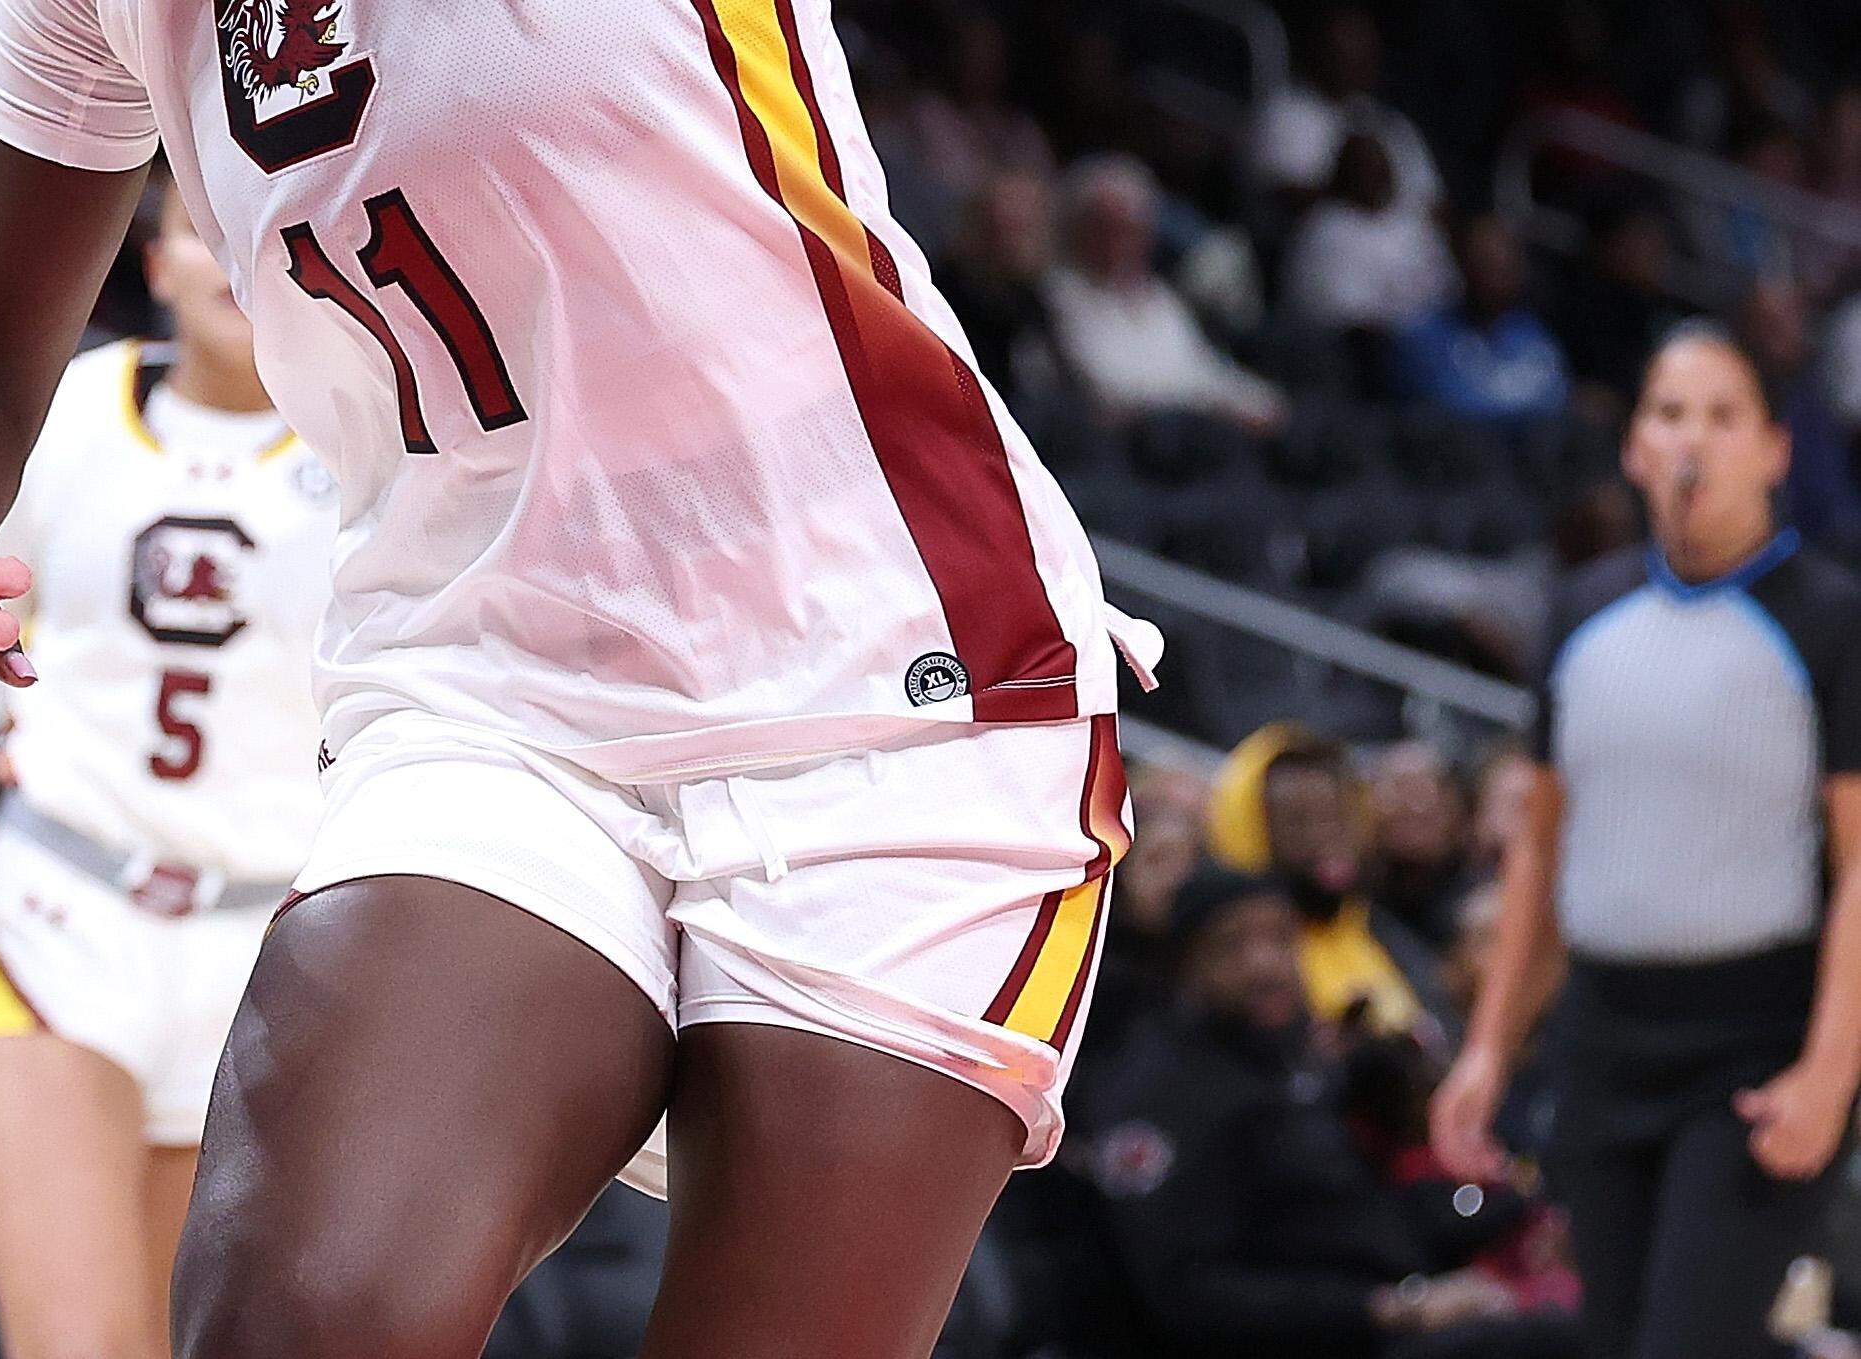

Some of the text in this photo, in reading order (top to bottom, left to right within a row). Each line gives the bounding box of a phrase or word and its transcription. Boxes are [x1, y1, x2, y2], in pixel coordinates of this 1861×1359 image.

[280, 187, 529, 454] 11
[149, 671, 210, 781] 5
[923, 670, 950, 689] XL
